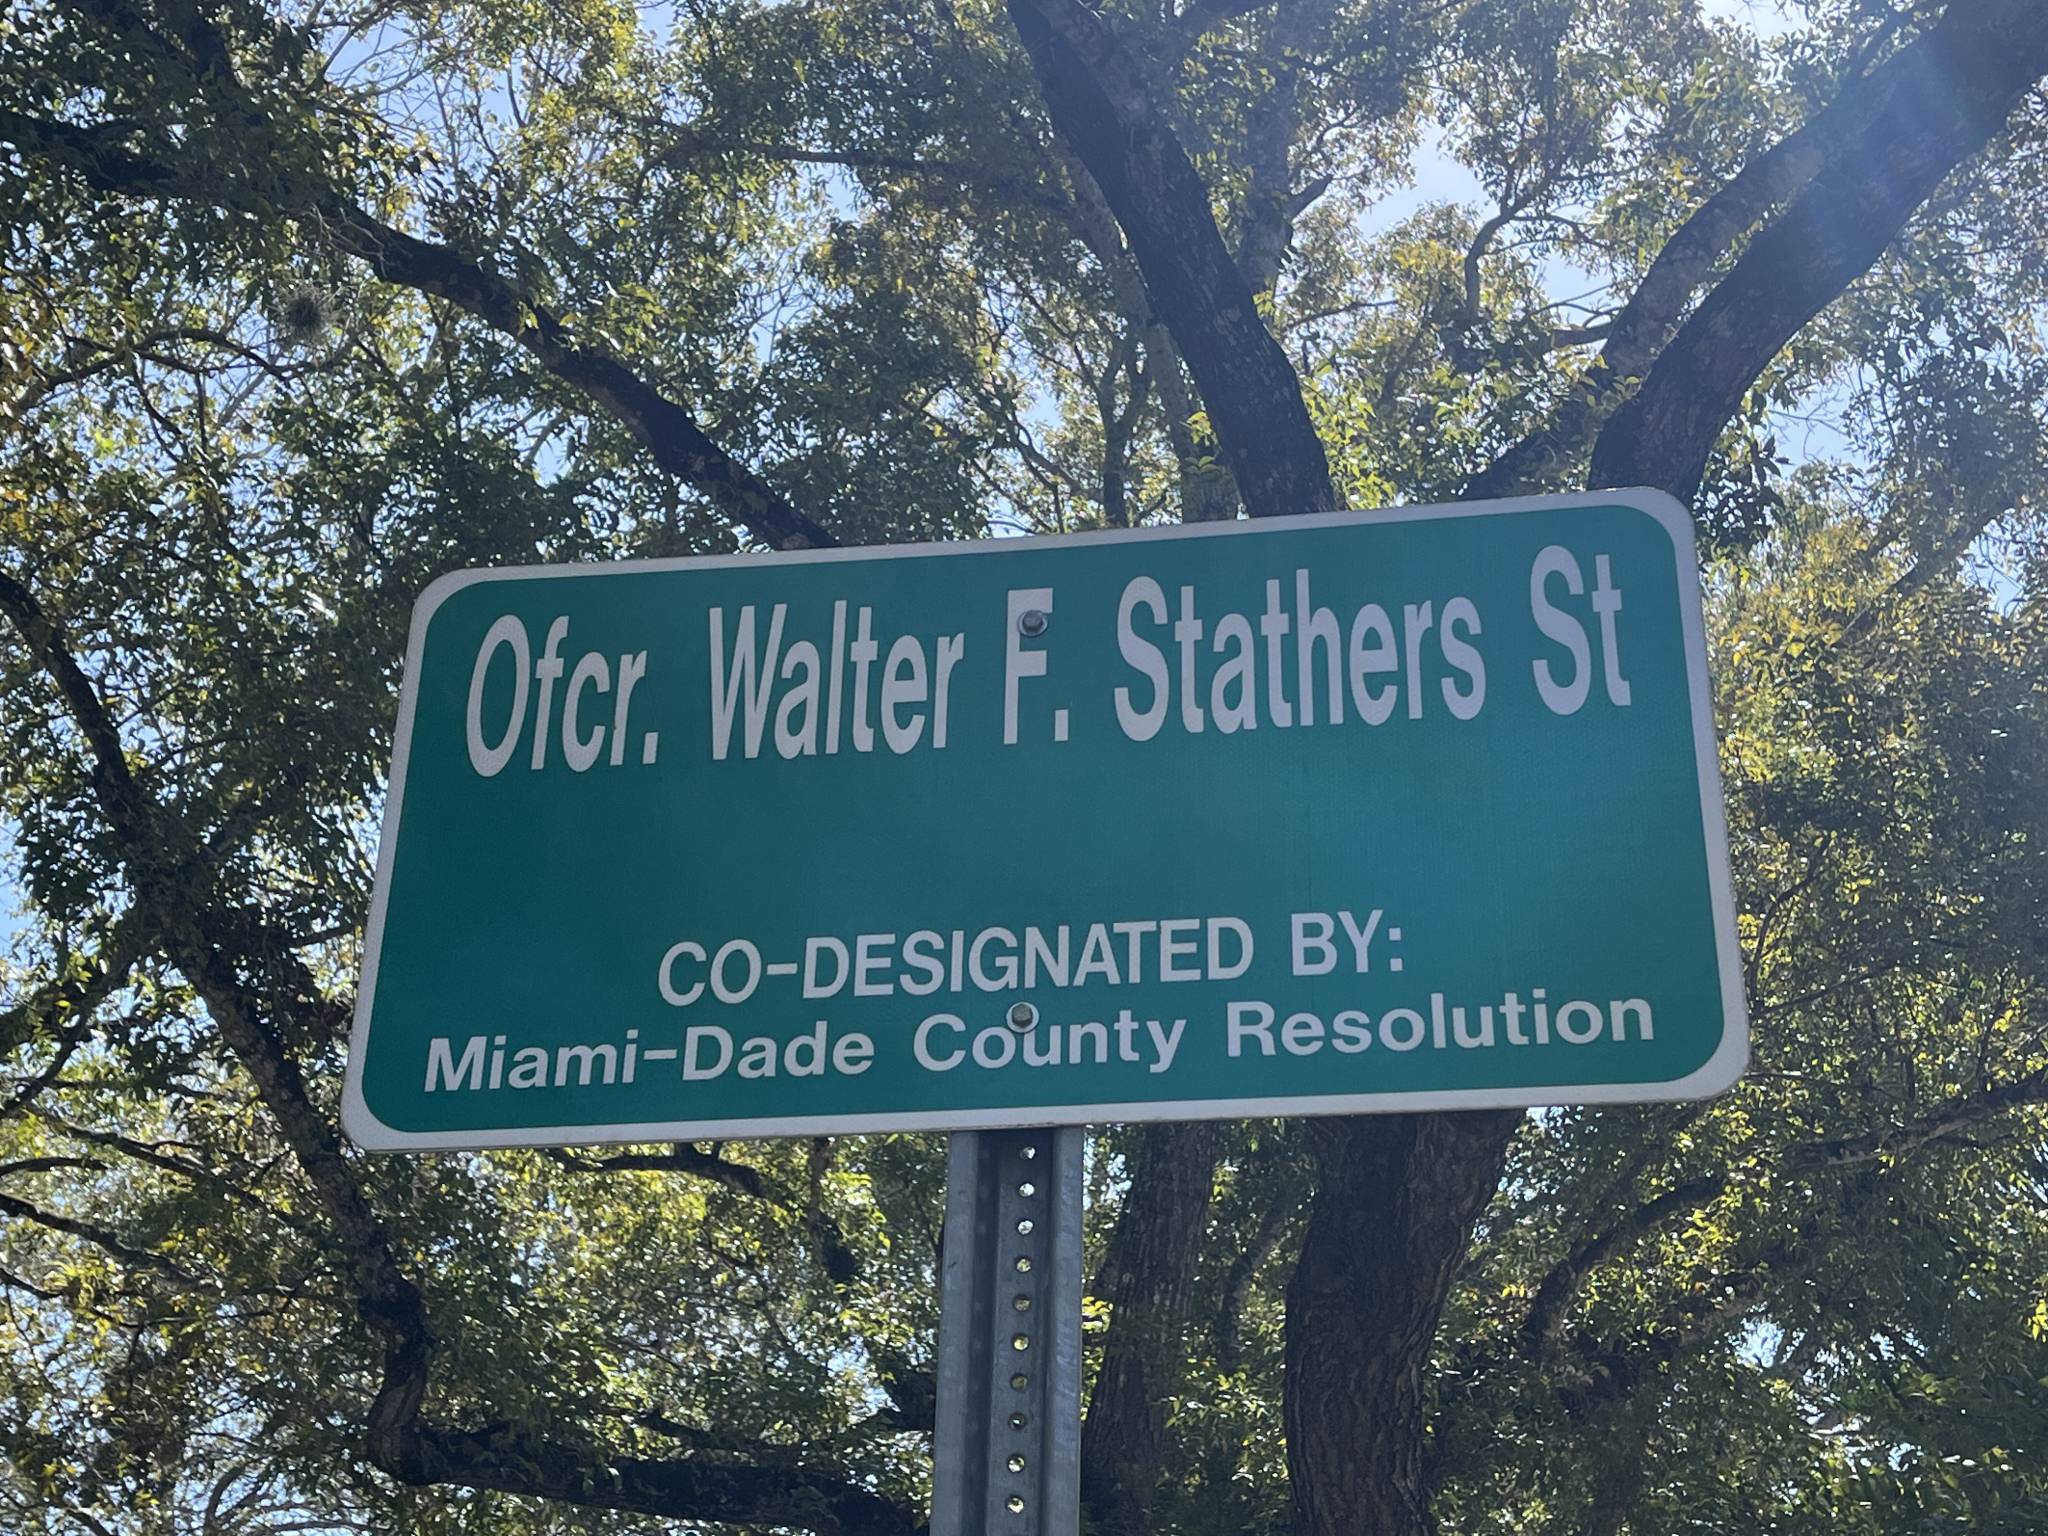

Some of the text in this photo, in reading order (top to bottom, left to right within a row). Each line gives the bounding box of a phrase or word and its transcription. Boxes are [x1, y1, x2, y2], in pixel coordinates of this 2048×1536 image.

[467, 545, 1631, 777] Ofcr. Walter F. Stathers St
[658, 909, 1403, 1006] CO-DESIGNATED BY:
[425, 988, 1654, 1091] Miami-Dade County Resolution
